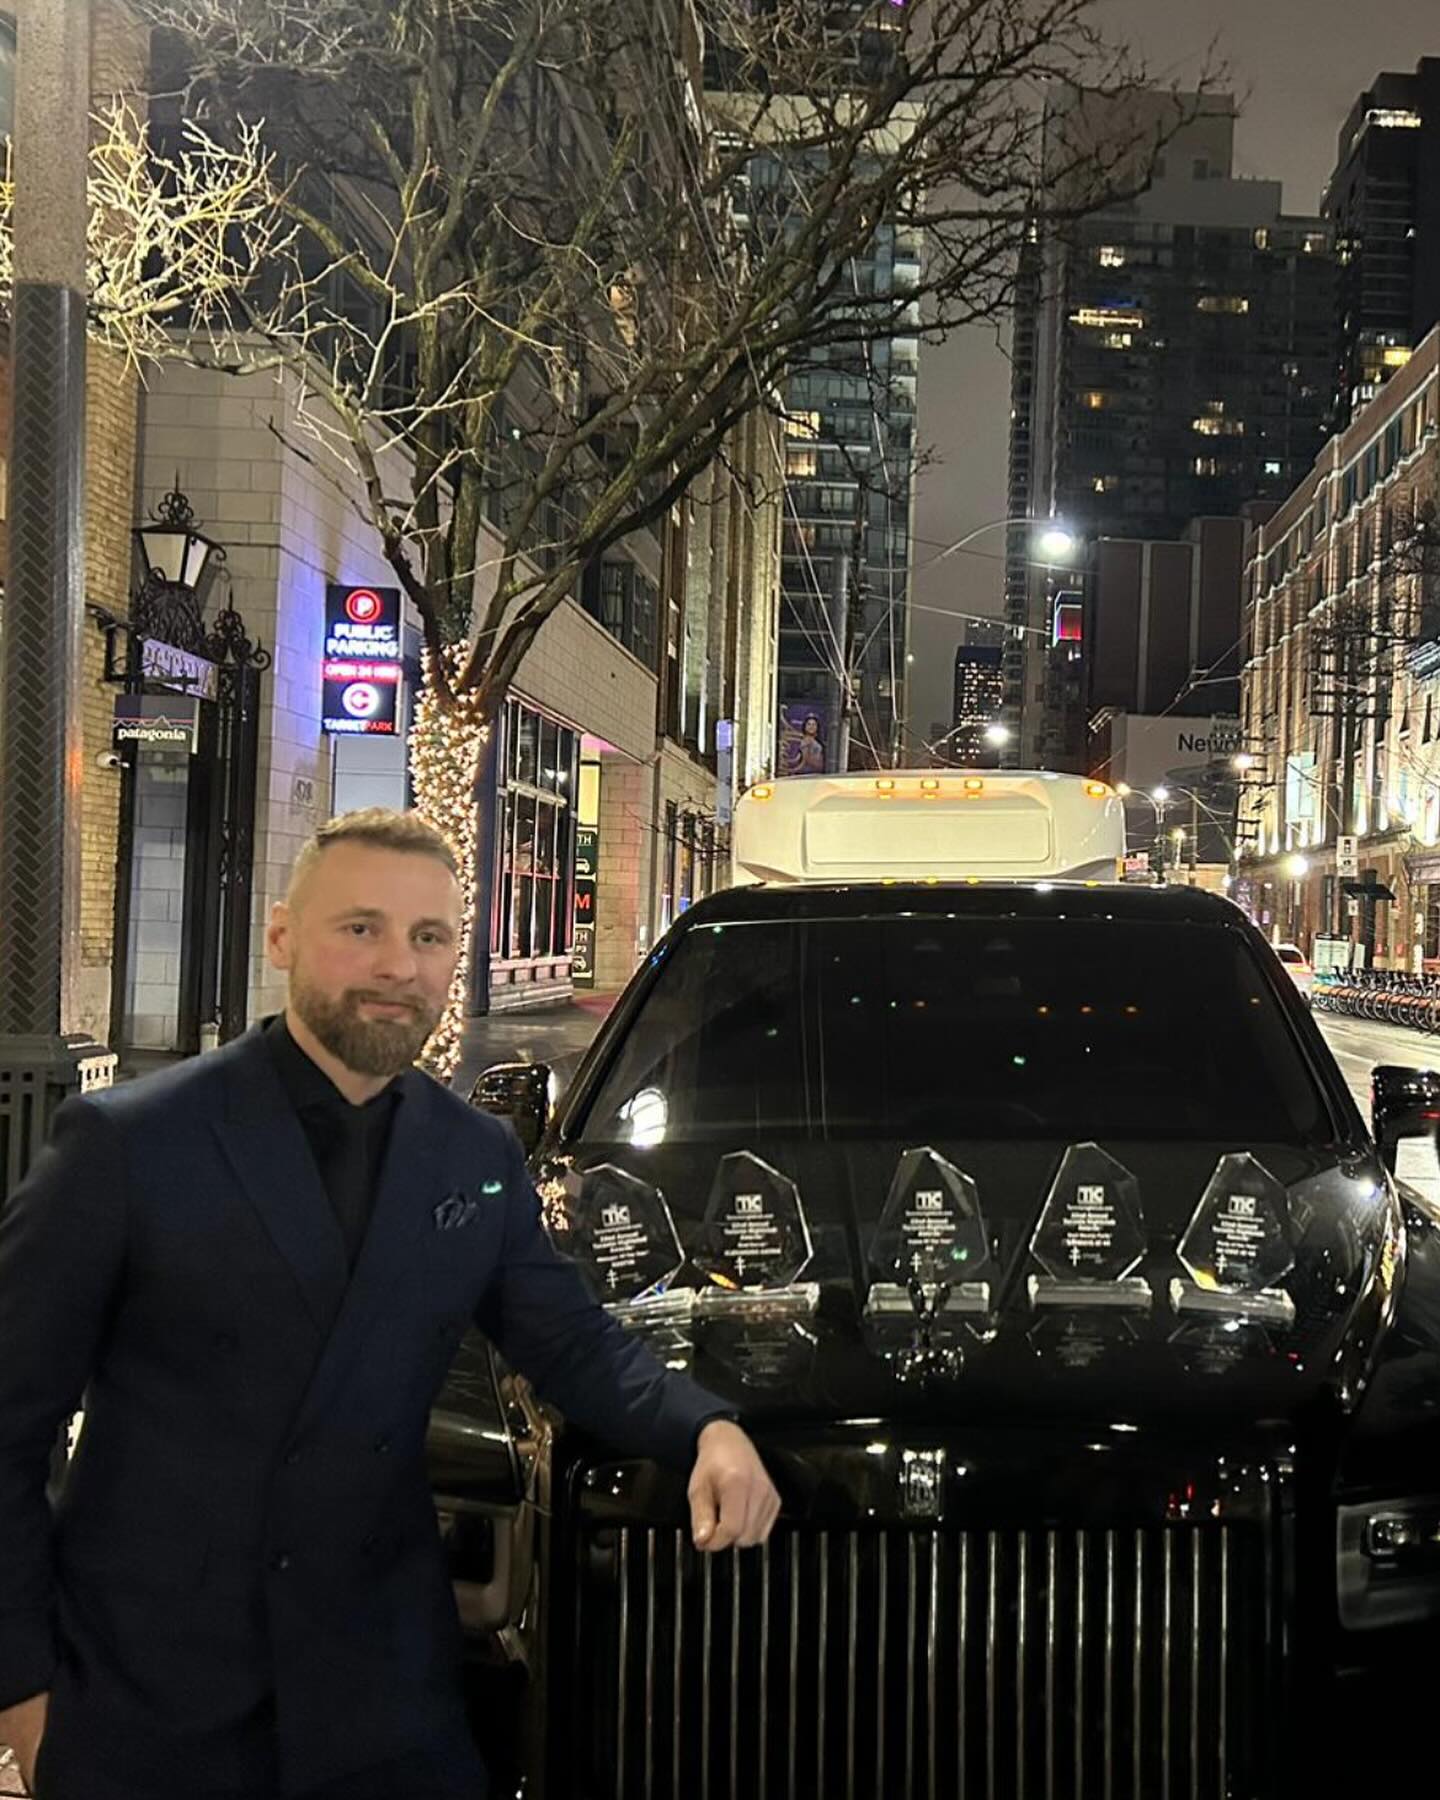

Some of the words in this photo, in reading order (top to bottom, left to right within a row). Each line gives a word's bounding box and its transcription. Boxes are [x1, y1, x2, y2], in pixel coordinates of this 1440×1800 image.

[333, 623, 394, 641] PUBLIC
[326, 638, 398, 657] PARKING
[117, 728, 187, 741] patagonia
